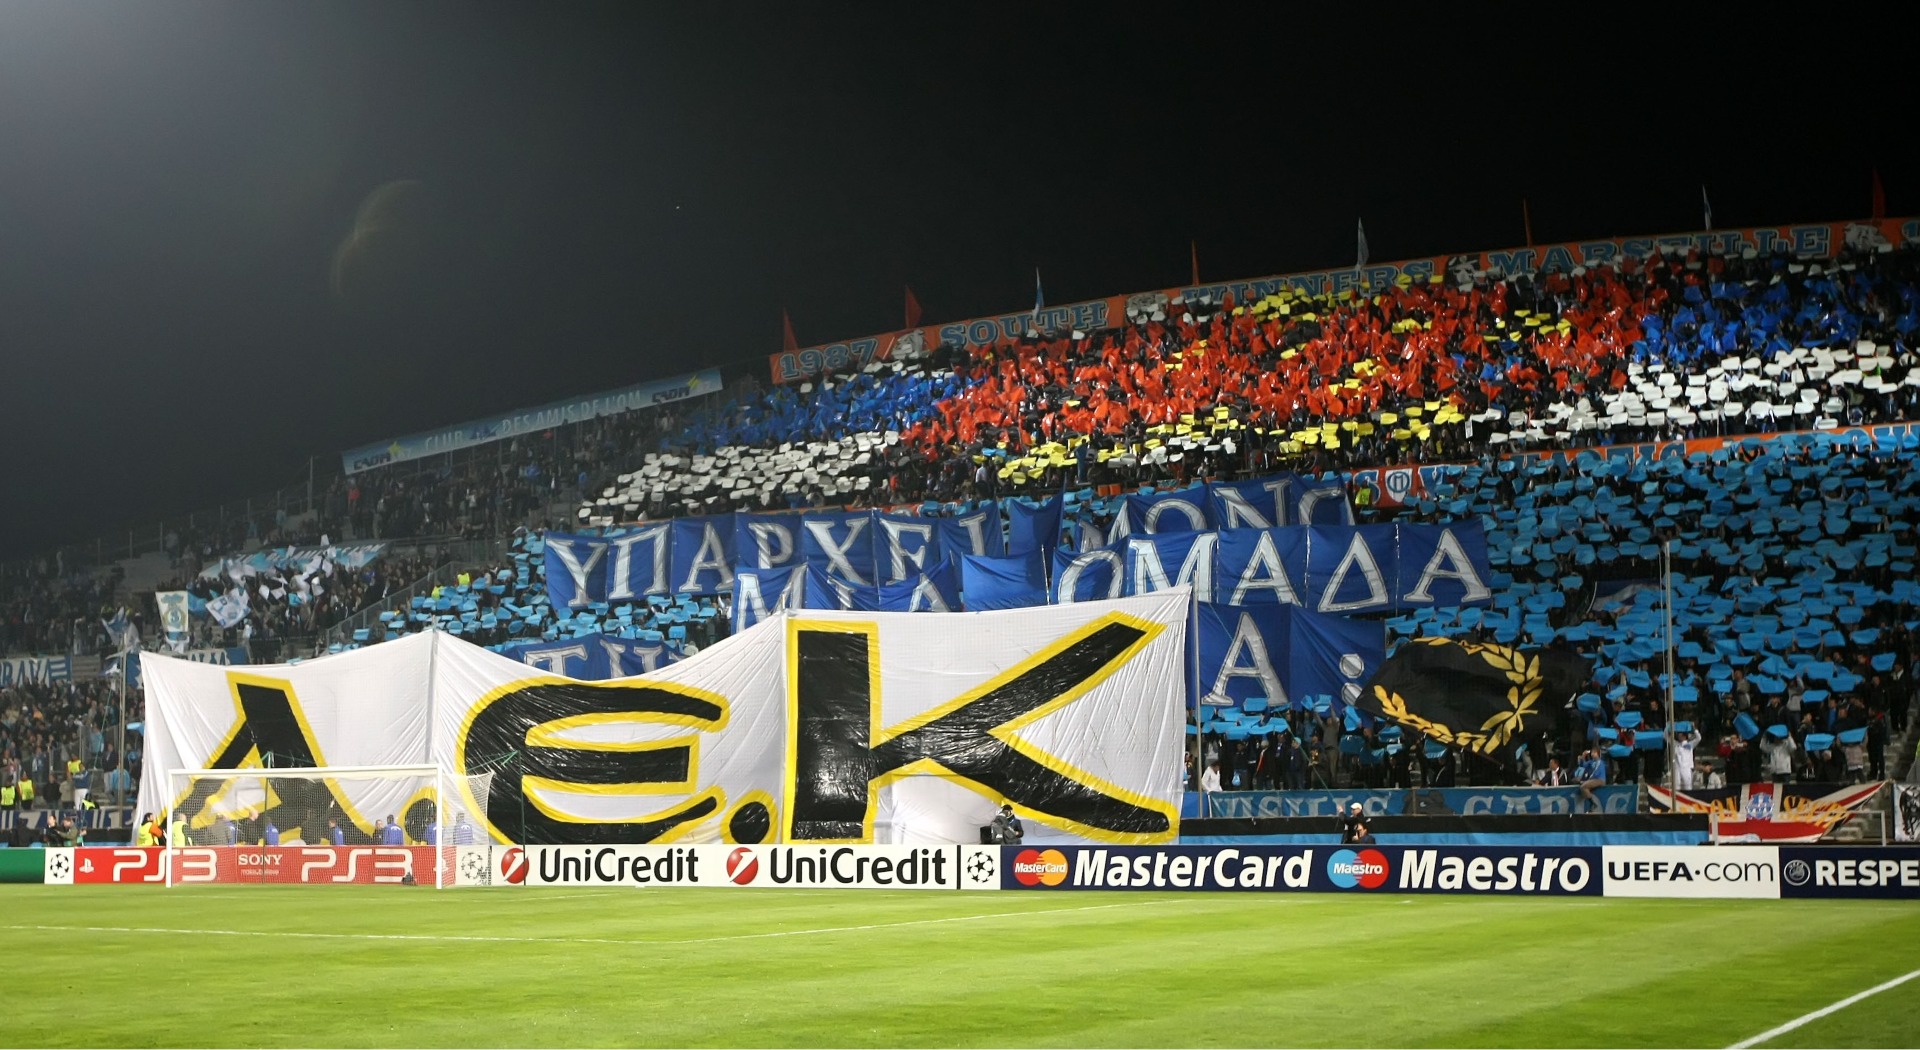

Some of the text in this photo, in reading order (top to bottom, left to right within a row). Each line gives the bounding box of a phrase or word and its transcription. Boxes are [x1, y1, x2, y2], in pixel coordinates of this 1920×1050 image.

[779, 338, 878, 379] 1987
[940, 300, 1108, 348] SOUTH
[532, 404, 575, 430] AMIS
[112, 848, 218, 882] PS3
[237, 854, 283, 866] SONY
[301, 848, 414, 882] PS3
[539, 847, 700, 885] UniCredit
[769, 847, 947, 886] UniCredit
[1014, 862, 1067, 875] MasterCard
[1073, 849, 1314, 888] MasterCard
[1332, 861, 1384, 875] Maestro
[1399, 849, 1591, 892] Maestro
[1815, 859, 1920, 887] RESPE
